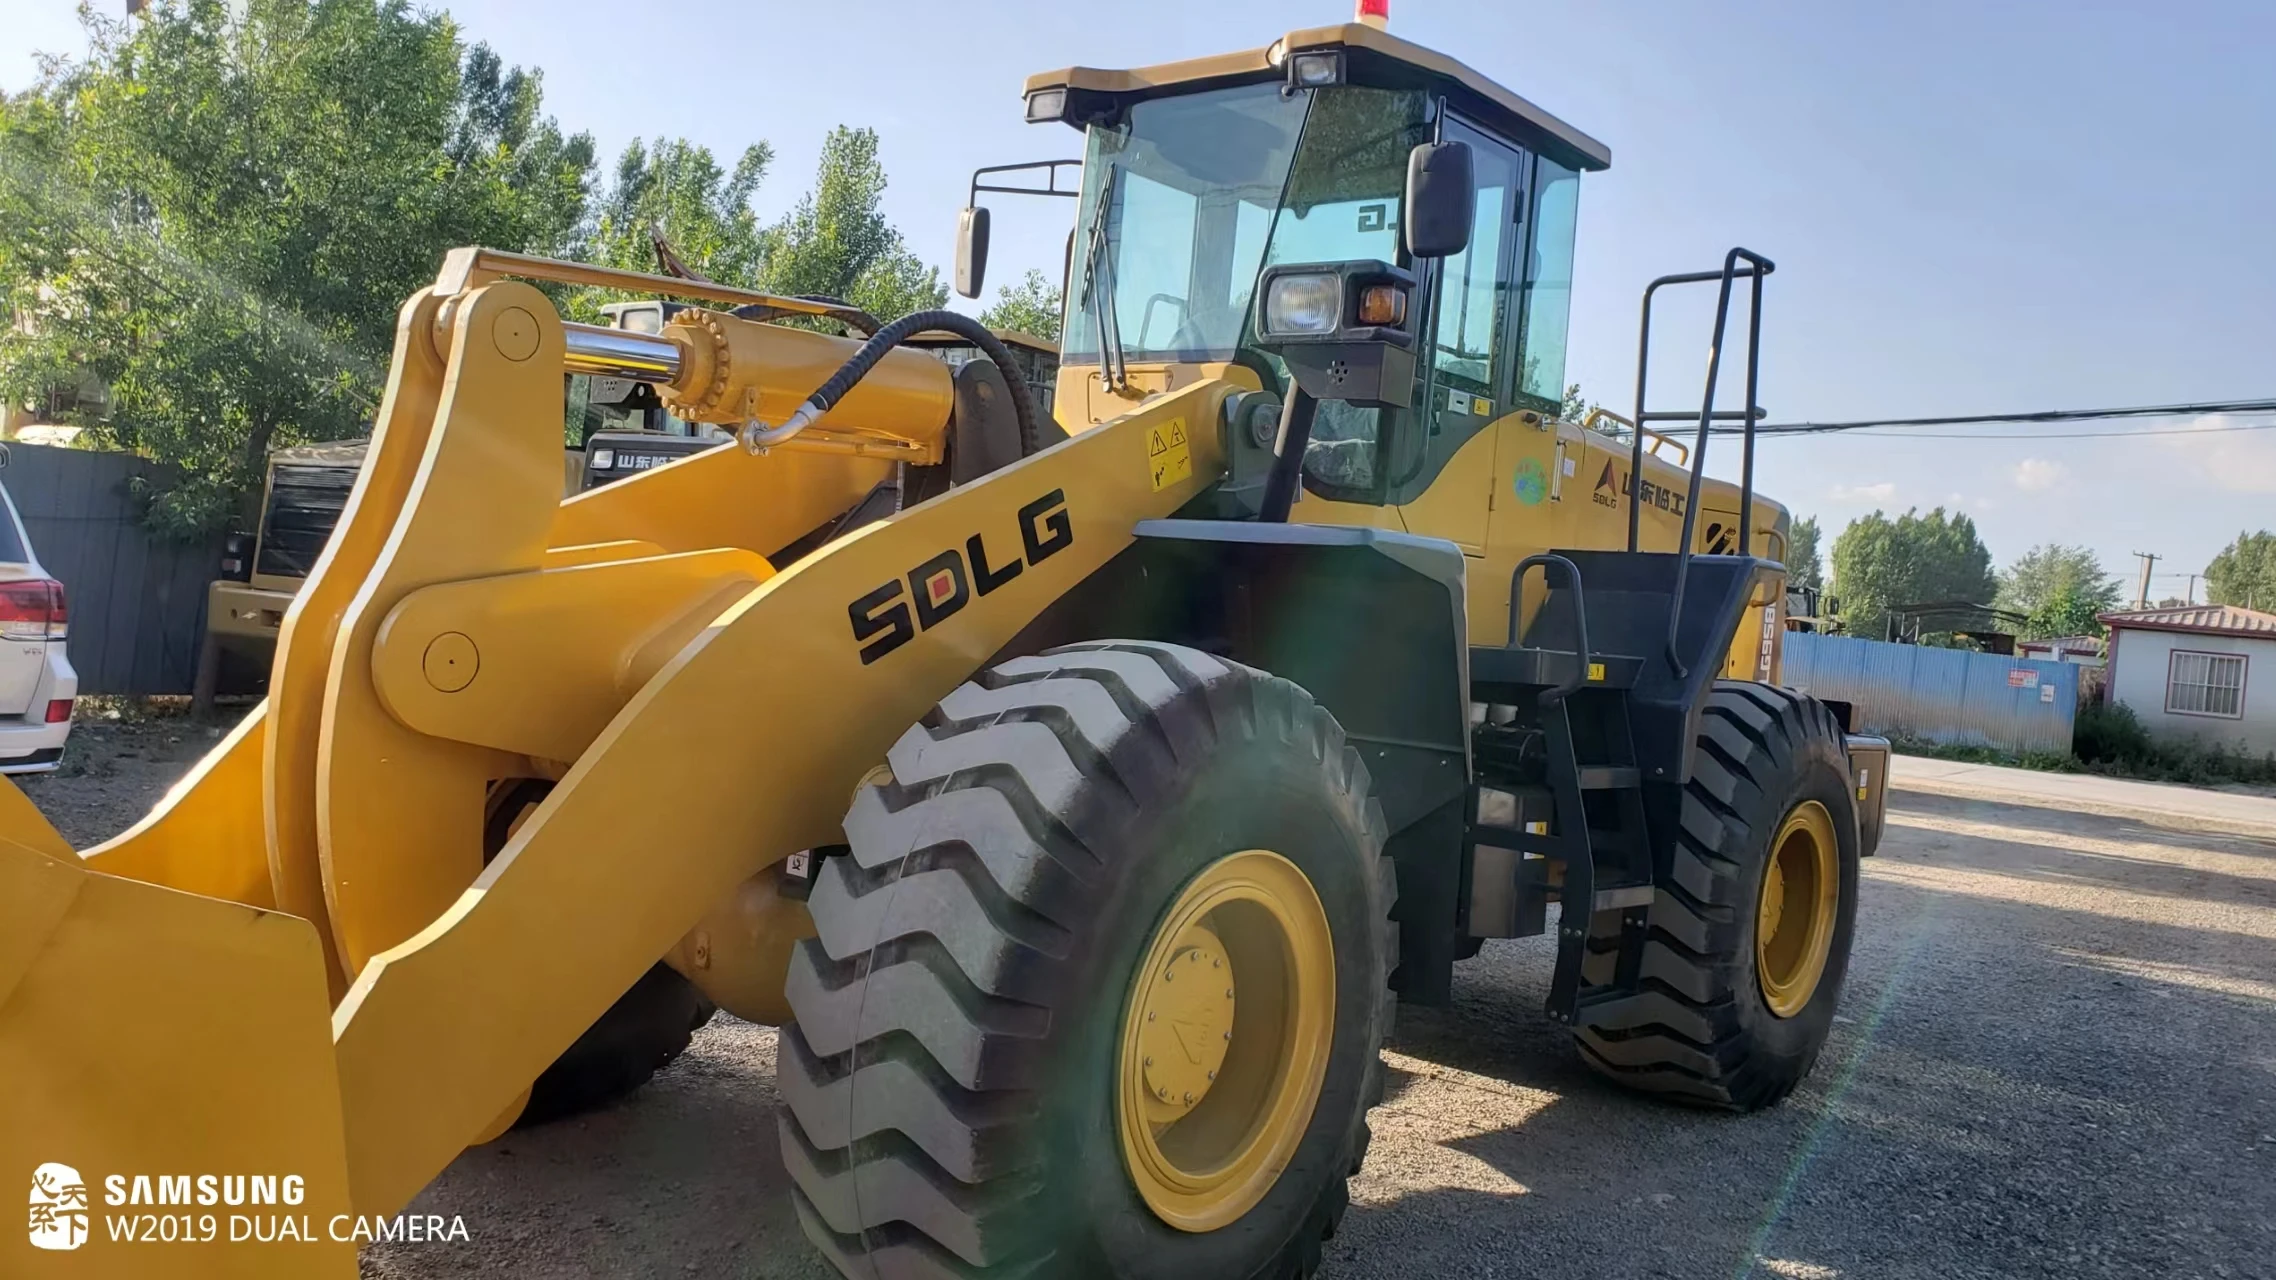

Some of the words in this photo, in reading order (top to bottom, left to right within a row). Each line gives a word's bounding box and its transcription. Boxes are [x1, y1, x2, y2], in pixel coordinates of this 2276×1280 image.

[617, 454, 683, 469] 山东临
[1593, 493, 1617, 509] SDLG
[848, 488, 1073, 666] SDLG
